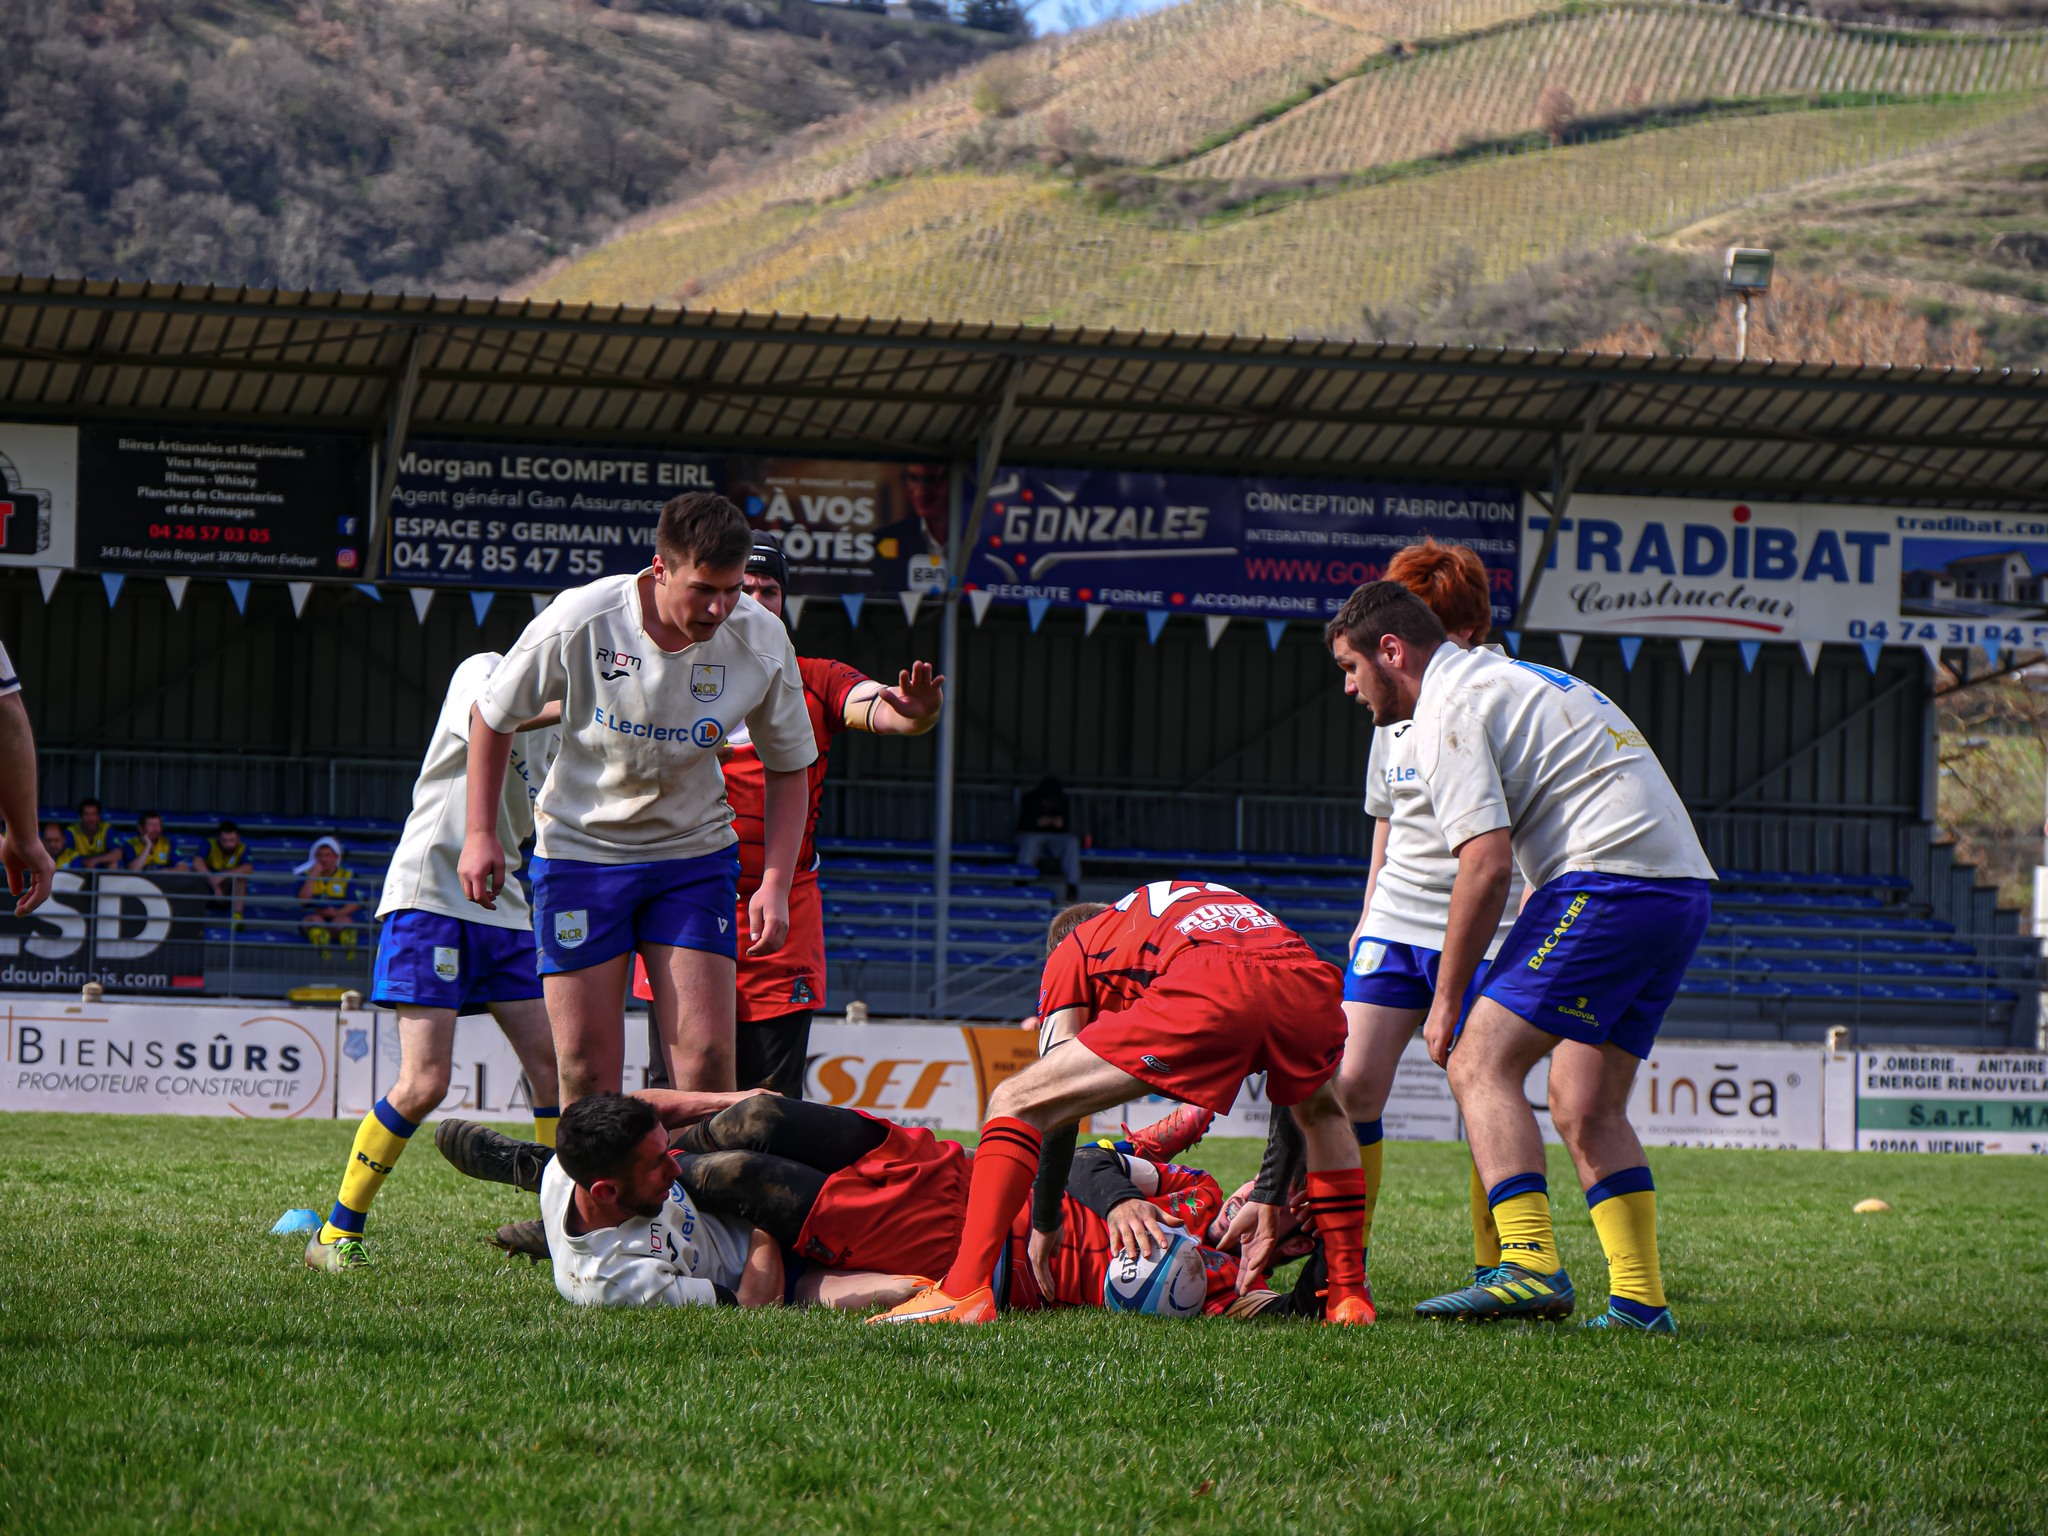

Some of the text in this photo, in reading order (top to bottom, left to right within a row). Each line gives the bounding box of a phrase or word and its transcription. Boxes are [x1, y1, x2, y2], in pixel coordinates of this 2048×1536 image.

[118, 438, 305, 459] Bières Artisanales et Régionales
[166, 456, 257, 473] Vins Régionaux
[399, 452, 714, 487] Morgan LECOMPTE EIRL
[164, 471, 257, 490] Rhums Whisky
[137, 486, 285, 504] Planches de Charcuteries
[390, 484, 665, 513] Agent général Gan Assurance
[764, 487, 875, 526] À VOS
[1245, 491, 1515, 523] CONCEPTION FABRICATION
[164, 503, 256, 519] et de Fromages
[149, 523, 271, 544] 04 26 57 03 05
[394, 517, 482, 541] ESPACE
[511, 521, 622, 546] GERMAIN
[627, 527, 657, 547] VIE
[1003, 505, 1210, 544] GONZALES
[1246, 529, 1329, 544] INTEGRATION
[1897, 515, 2048, 535] tradibat.co
[122, 547, 142, 559] Rue
[143, 548, 171, 560] Louis
[173, 549, 214, 564] Breguet
[393, 540, 604, 575] 04 74 85 47 55
[986, 583, 1071, 602] RECRUTE
[1099, 588, 1164, 604] FORME
[1191, 592, 1317, 612] ACCOMPAGNE
[1570, 581, 1794, 618] Constructeur
[1849, 620, 1889, 641] 04
[1900, 621, 1937, 641] 74
[1948, 623, 1975, 644] 31
[595, 707, 688, 743] E.Leclerc
[0, 871, 172, 960] SD
[1527, 891, 1592, 970] BACACIER
[1558, 1005, 1595, 1021] EUROVIA
[1868, 1057, 1955, 1072] POMBERIE
[17, 1072, 300, 1098] PROMOTEUR CONSTRUCTIF
[1868, 1075, 2048, 1092] ENERGIE RENOUVELA
[1909, 1104, 2048, 1128] S.a.r.l. MA
